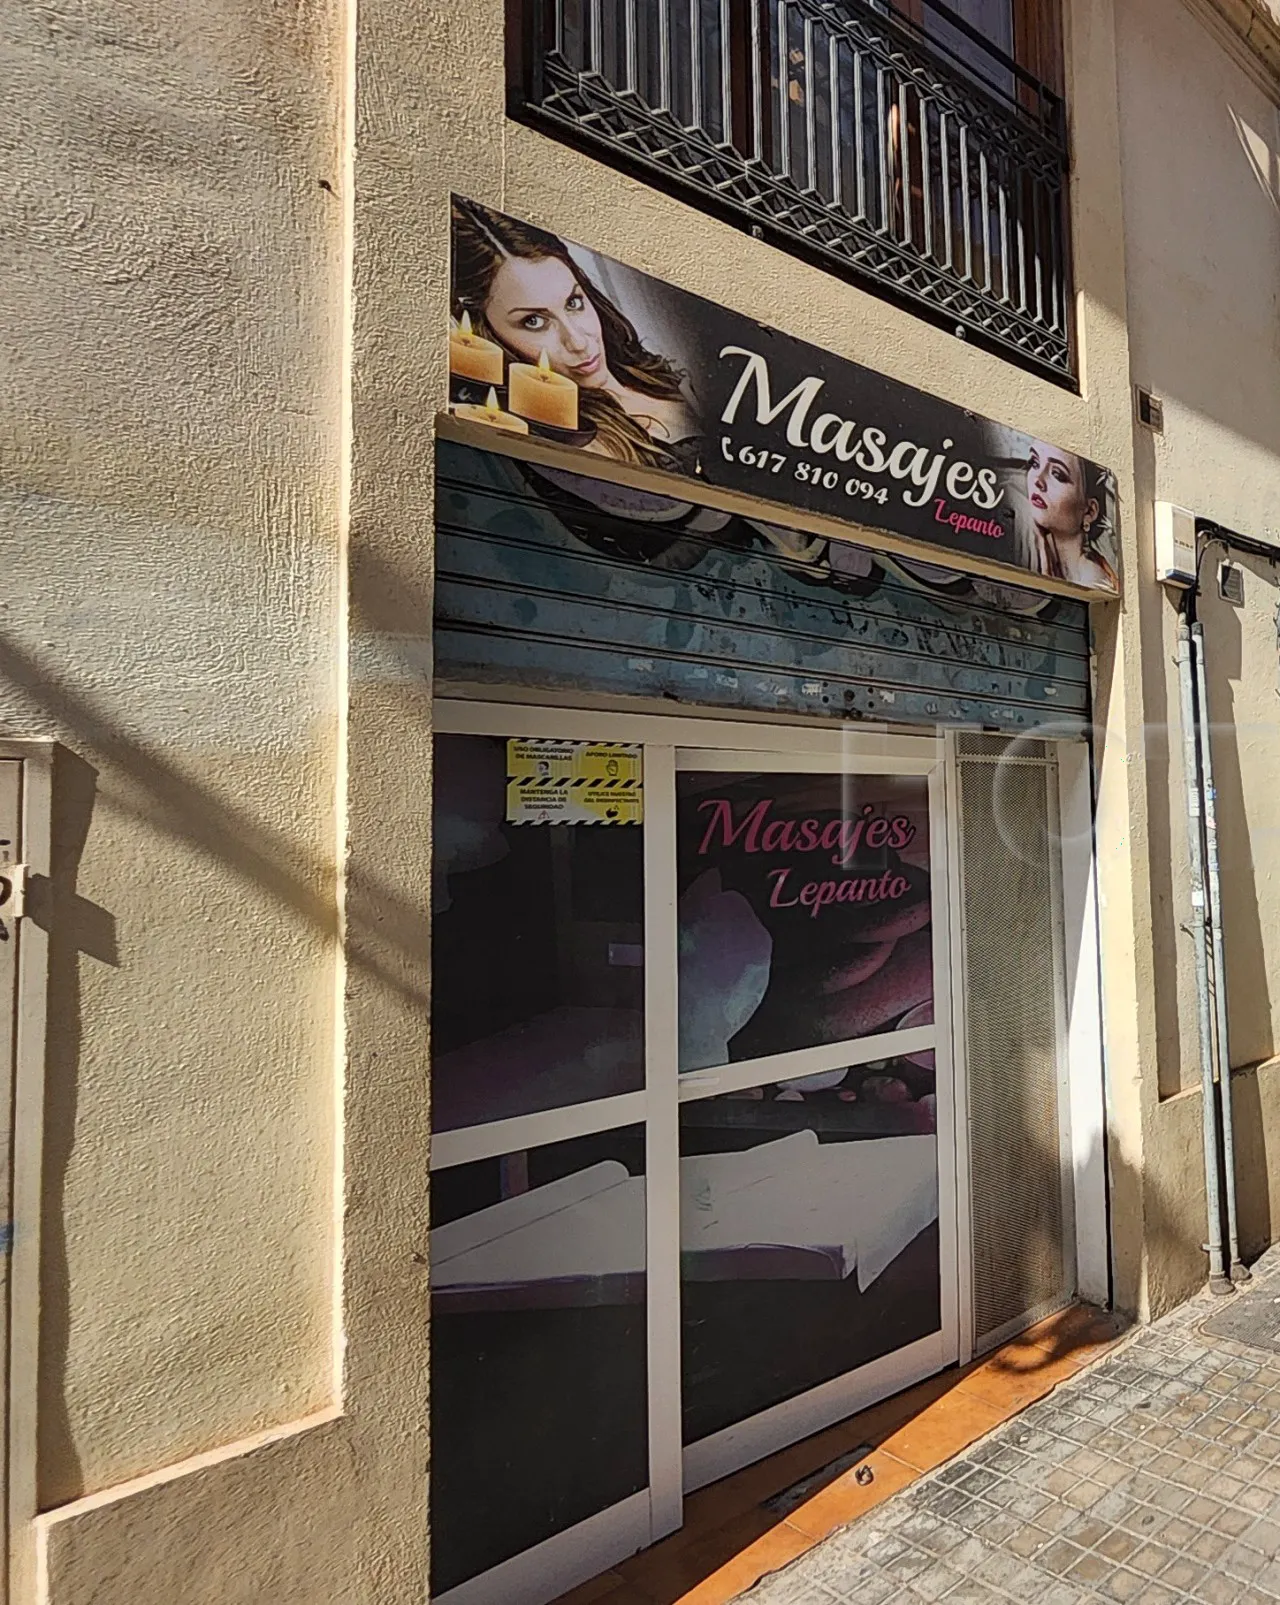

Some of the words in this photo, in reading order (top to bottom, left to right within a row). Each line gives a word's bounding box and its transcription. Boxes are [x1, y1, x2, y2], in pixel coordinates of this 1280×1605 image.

[719, 346, 1005, 509] Masajes
[739, 446, 787, 473] 617
[794, 462, 838, 489] 810
[845, 481, 888, 504] 094
[934, 497, 1005, 538] Lepanto
[697, 799, 916, 864] Masajes
[768, 868, 912, 919] Lepanto
